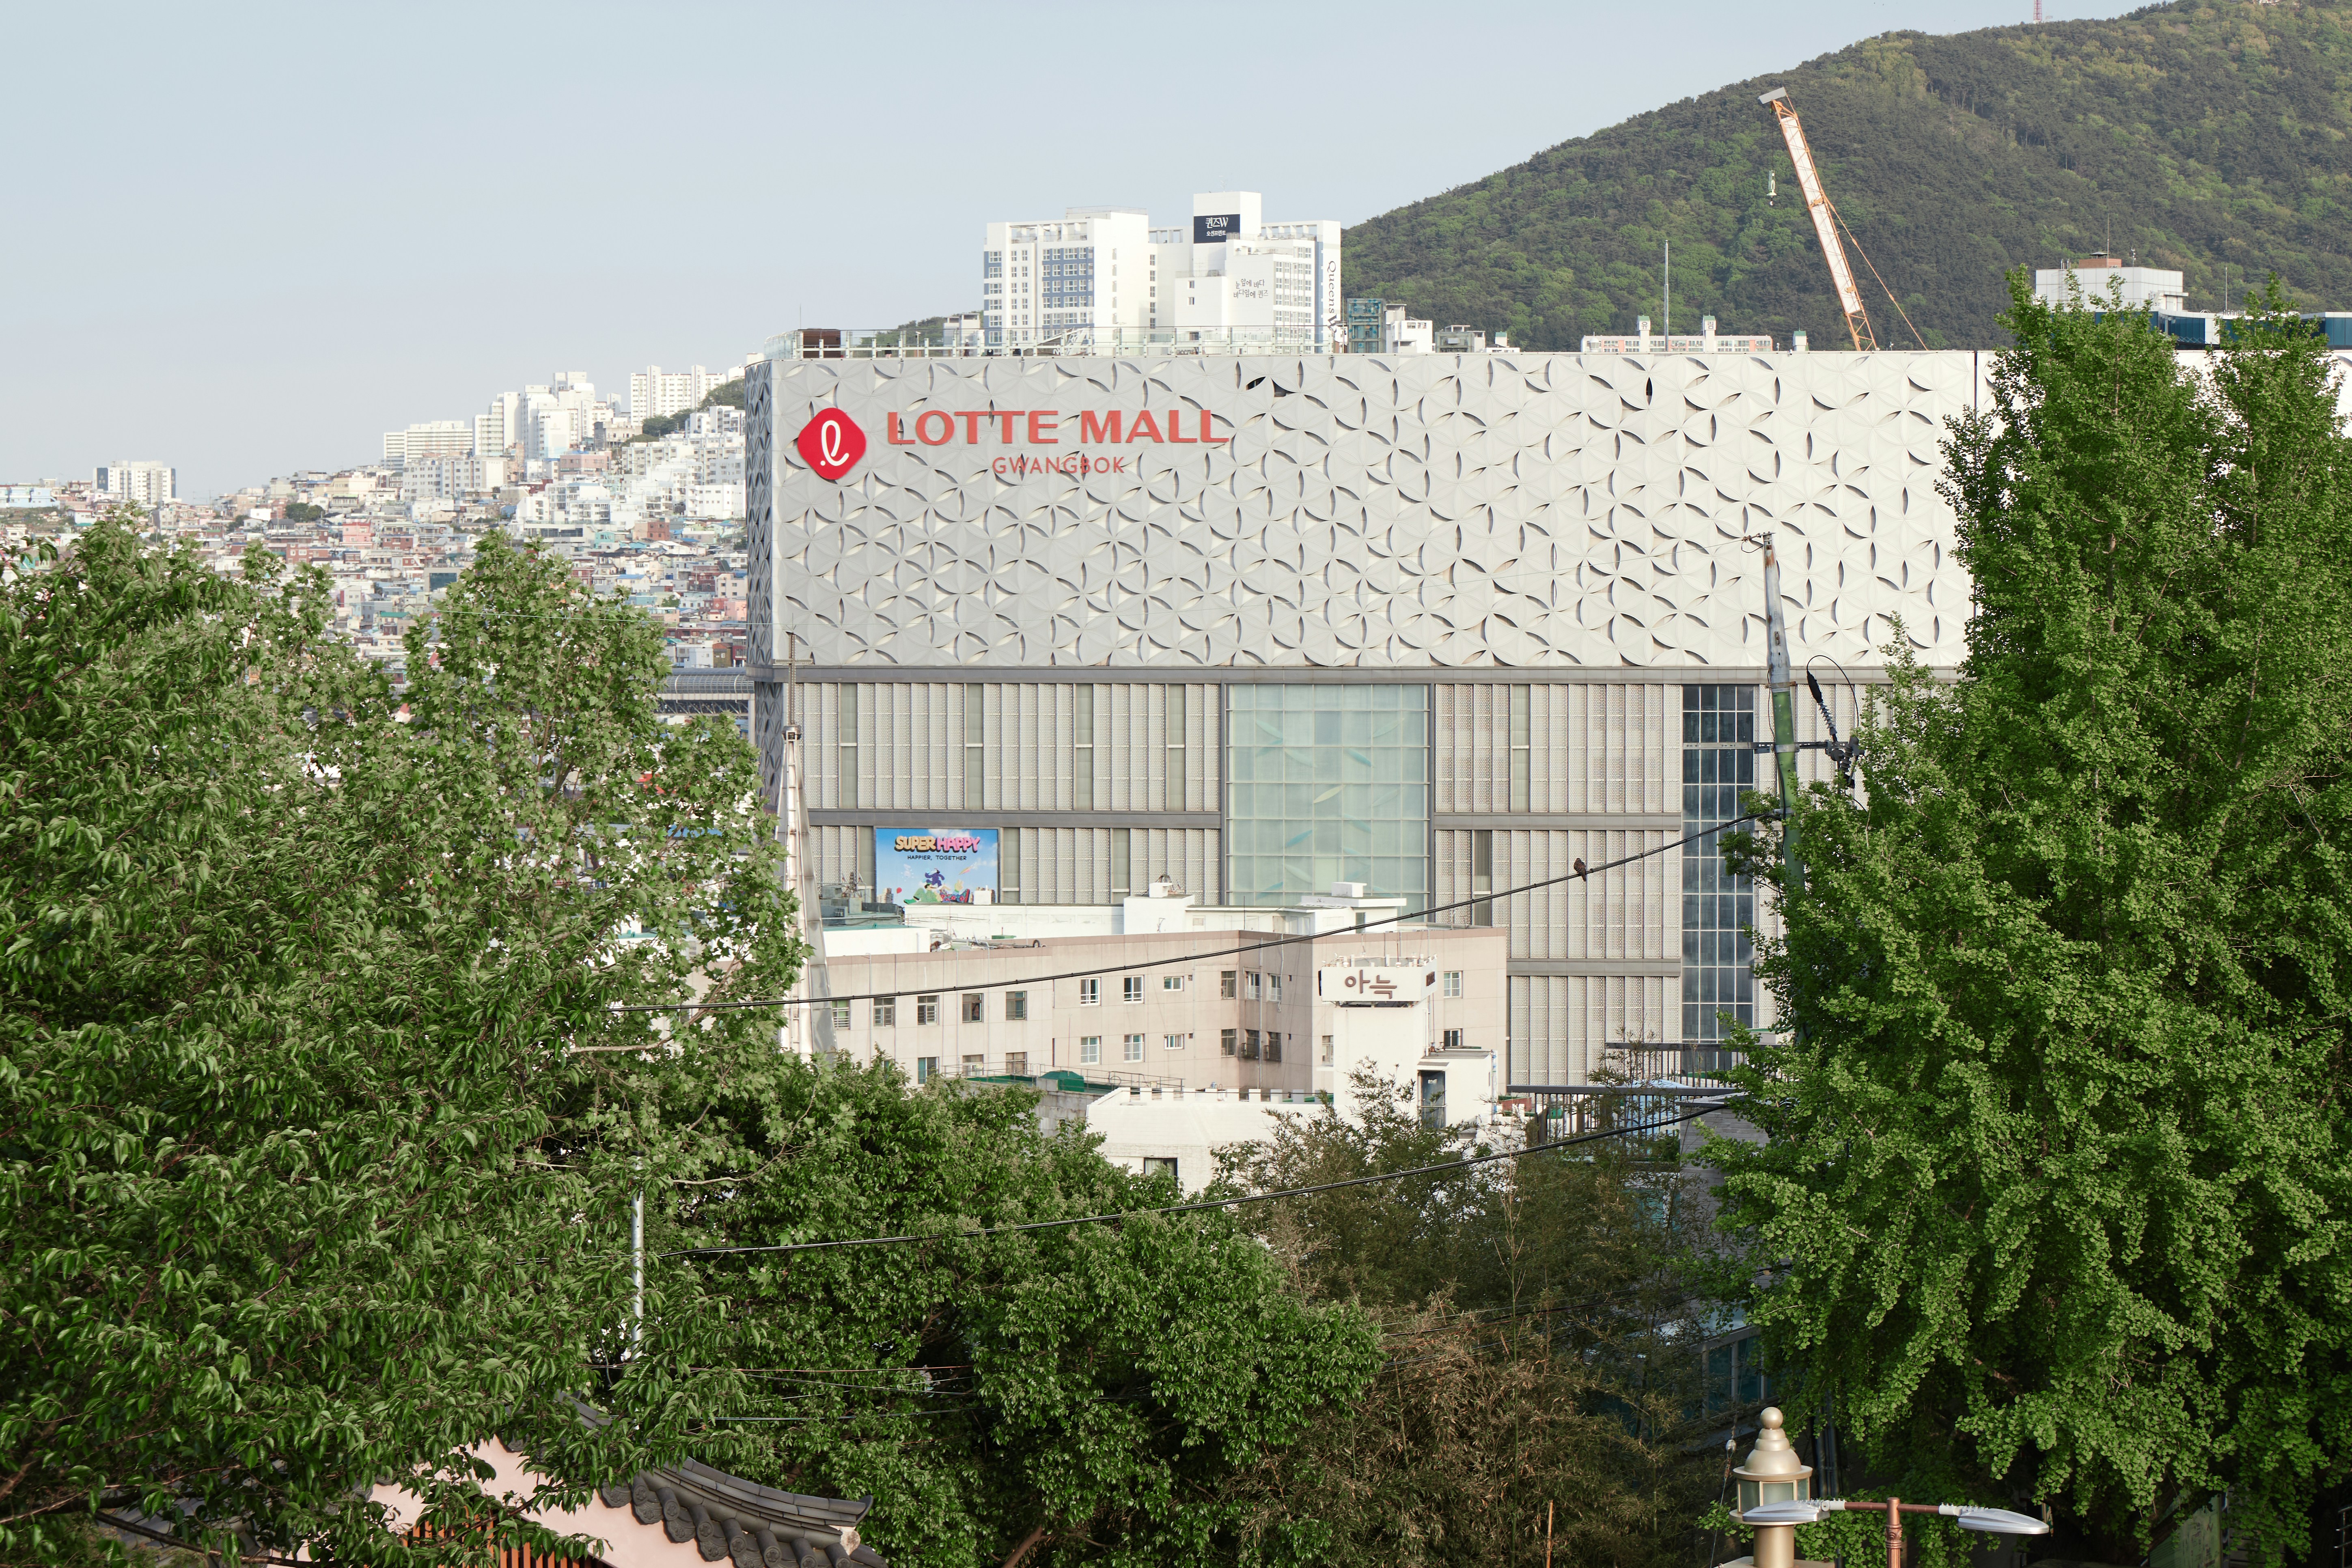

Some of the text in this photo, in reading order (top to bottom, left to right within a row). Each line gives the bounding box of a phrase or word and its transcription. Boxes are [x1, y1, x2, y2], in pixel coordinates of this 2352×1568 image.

[1205, 217, 1229, 228] 퀸즈W
[1253, 279, 1265, 288] 바다
[1257, 290, 1268, 298] 퀸즈
[1641, 321, 1714, 330] 유 림
[888, 409, 1230, 446] LOTTE MALL
[992, 456, 1125, 474] GWANGBOK
[894, 836, 980, 853] SUPER HAPPY
[1345, 969, 1397, 999] 아늑
